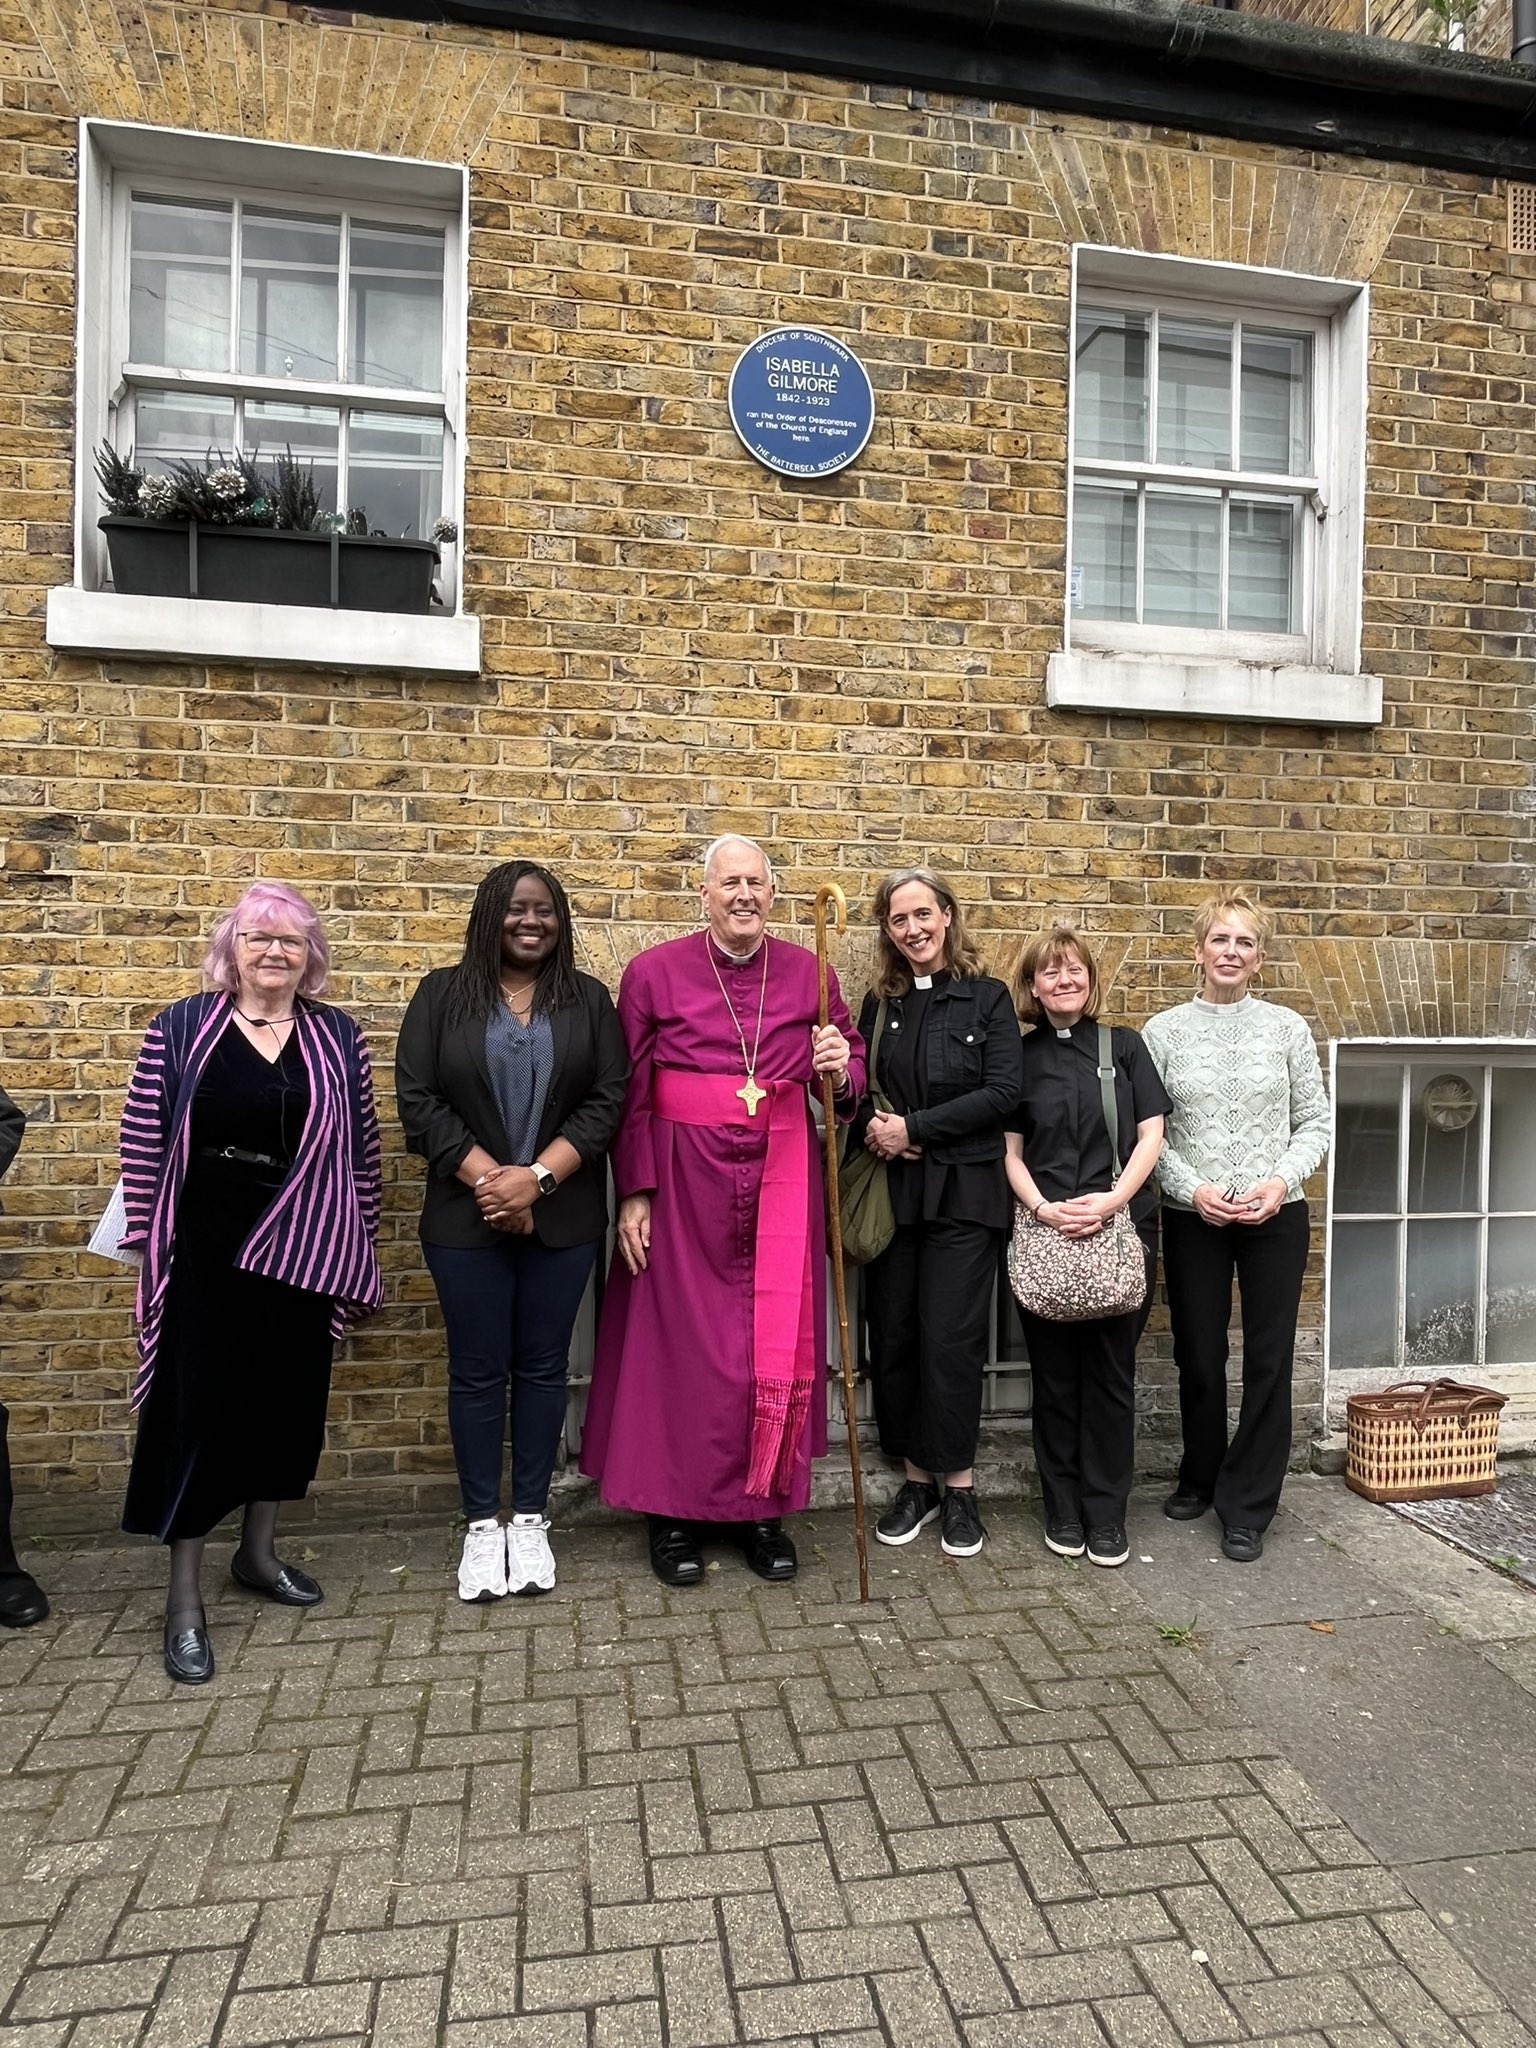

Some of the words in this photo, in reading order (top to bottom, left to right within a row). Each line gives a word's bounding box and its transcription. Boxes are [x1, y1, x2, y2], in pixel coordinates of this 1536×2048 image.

[755, 333, 787, 353] DIOCESE
[790, 332, 801, 340] OF
[803, 333, 850, 363] SOUTHWARK
[766, 356, 840, 378] ISABELLA
[768, 373, 838, 394] GILMORE
[761, 411, 774, 420] the
[776, 412, 797, 422] Order
[798, 415, 807, 423] of
[808, 416, 857, 428] Deaconesses
[765, 421, 778, 430] the
[780, 423, 807, 432] Church
[808, 426, 817, 434] of
[818, 426, 848, 437] England
[755, 443, 769, 459] THE
[770, 456, 816, 472] BATTERSEA
[817, 451, 848, 471] SOCIETY
